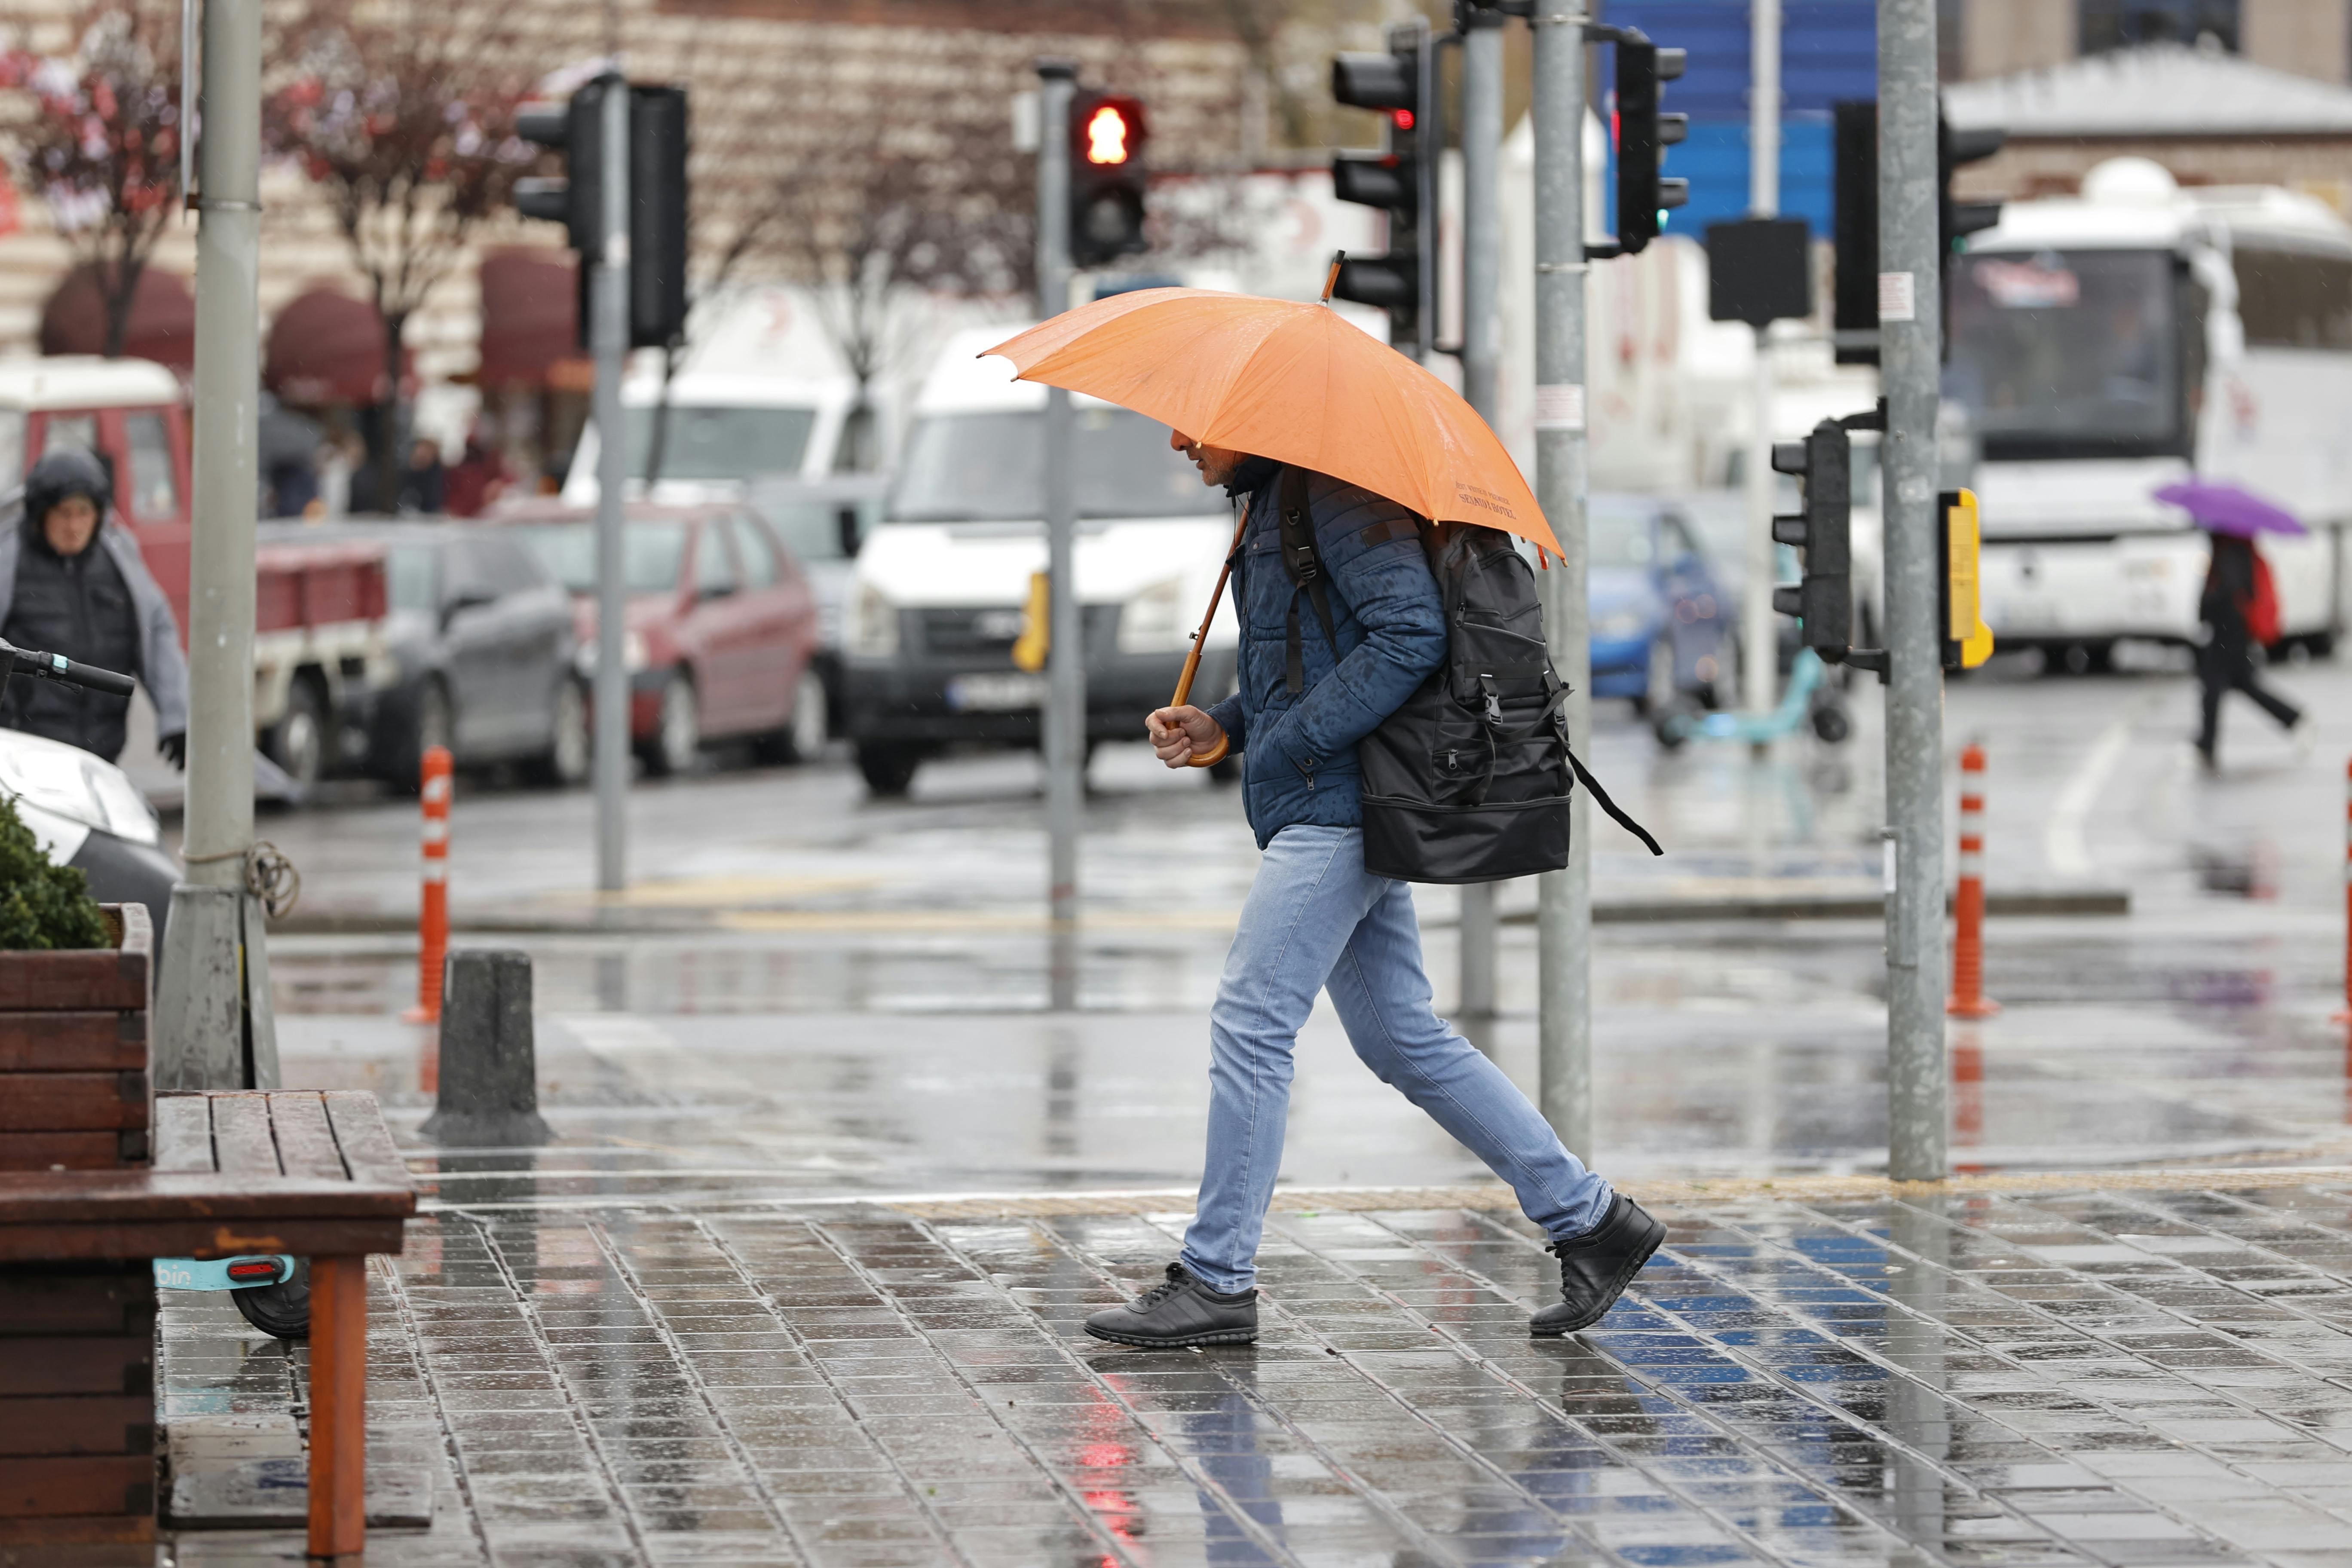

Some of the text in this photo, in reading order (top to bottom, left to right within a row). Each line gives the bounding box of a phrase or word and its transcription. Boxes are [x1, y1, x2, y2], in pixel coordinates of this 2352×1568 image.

[1459, 493, 1516, 520] SENATOR HOTEL
[157, 1264, 191, 1286] bin
